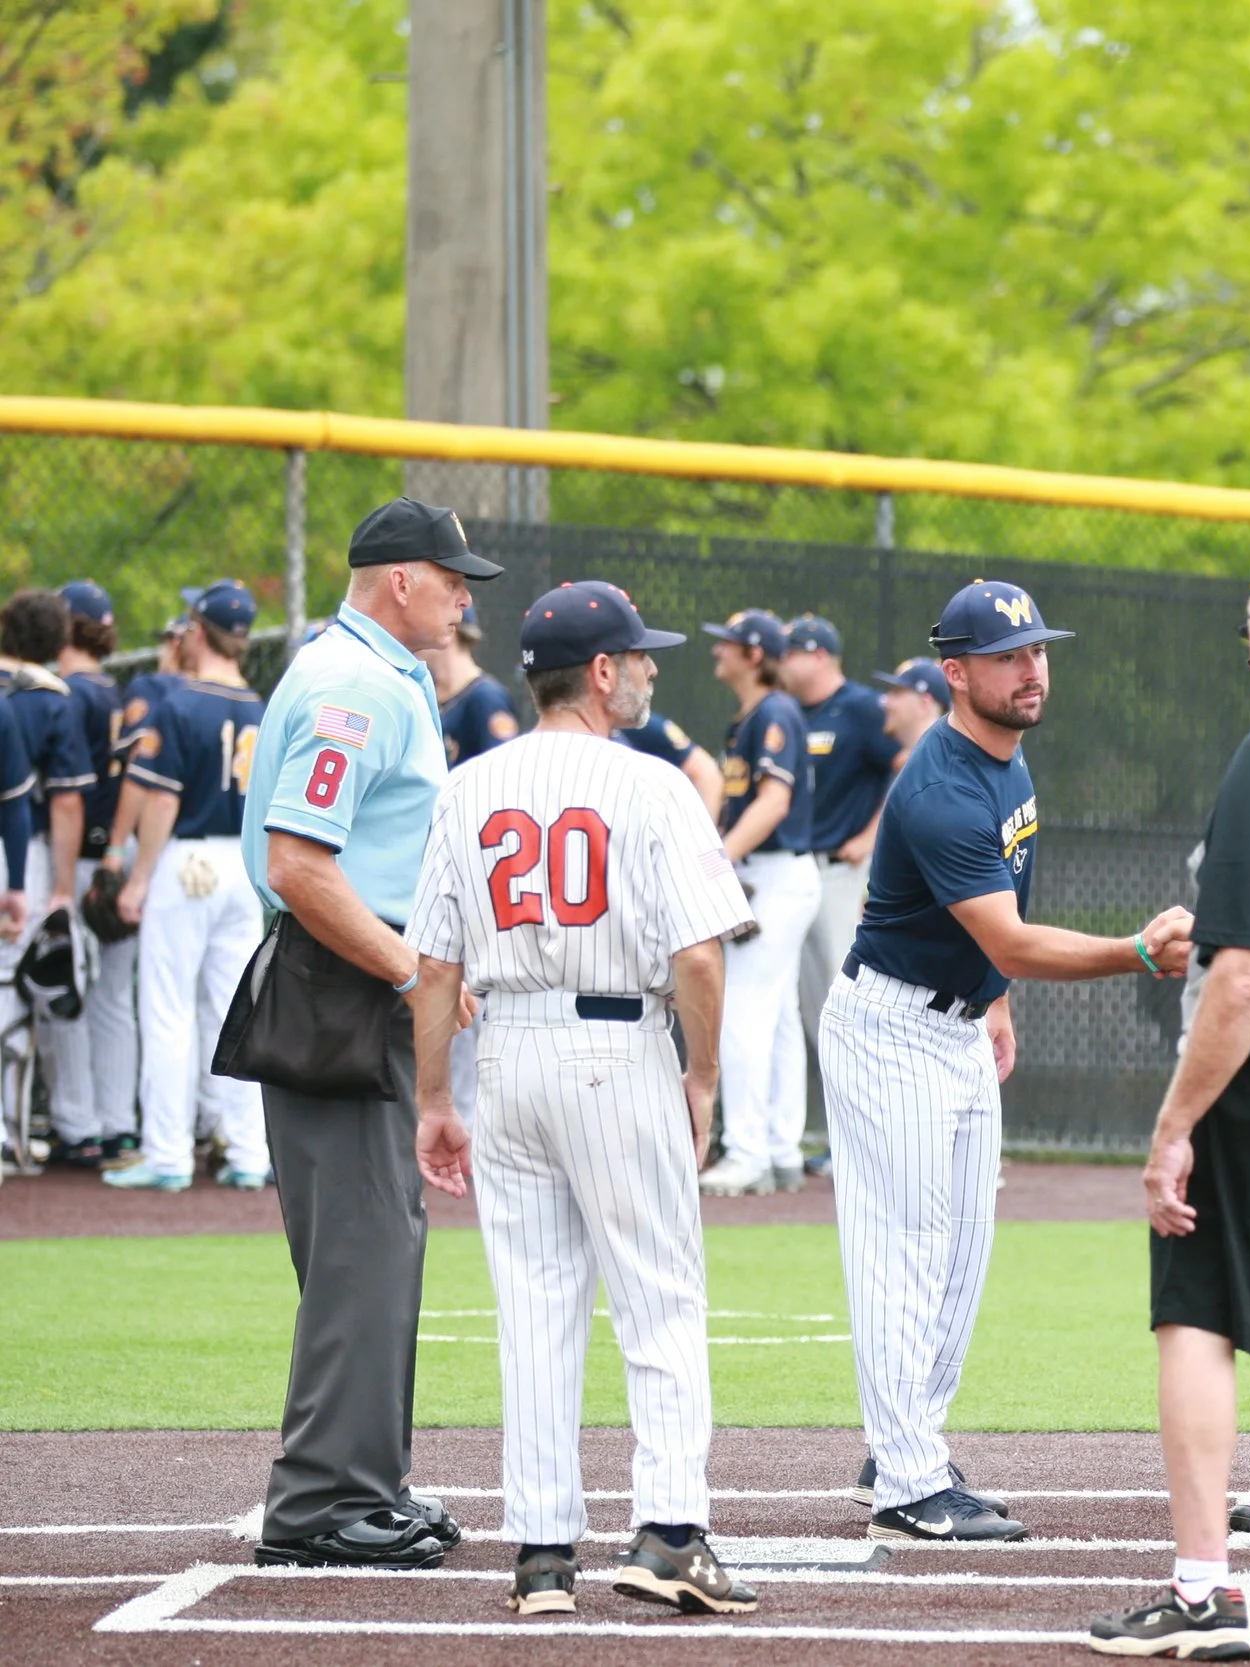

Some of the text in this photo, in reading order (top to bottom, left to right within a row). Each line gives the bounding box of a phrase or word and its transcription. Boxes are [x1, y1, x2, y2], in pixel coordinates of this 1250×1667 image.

[995, 594, 1032, 627] W
[305, 746, 350, 811] 8
[479, 807, 611, 932] 20
